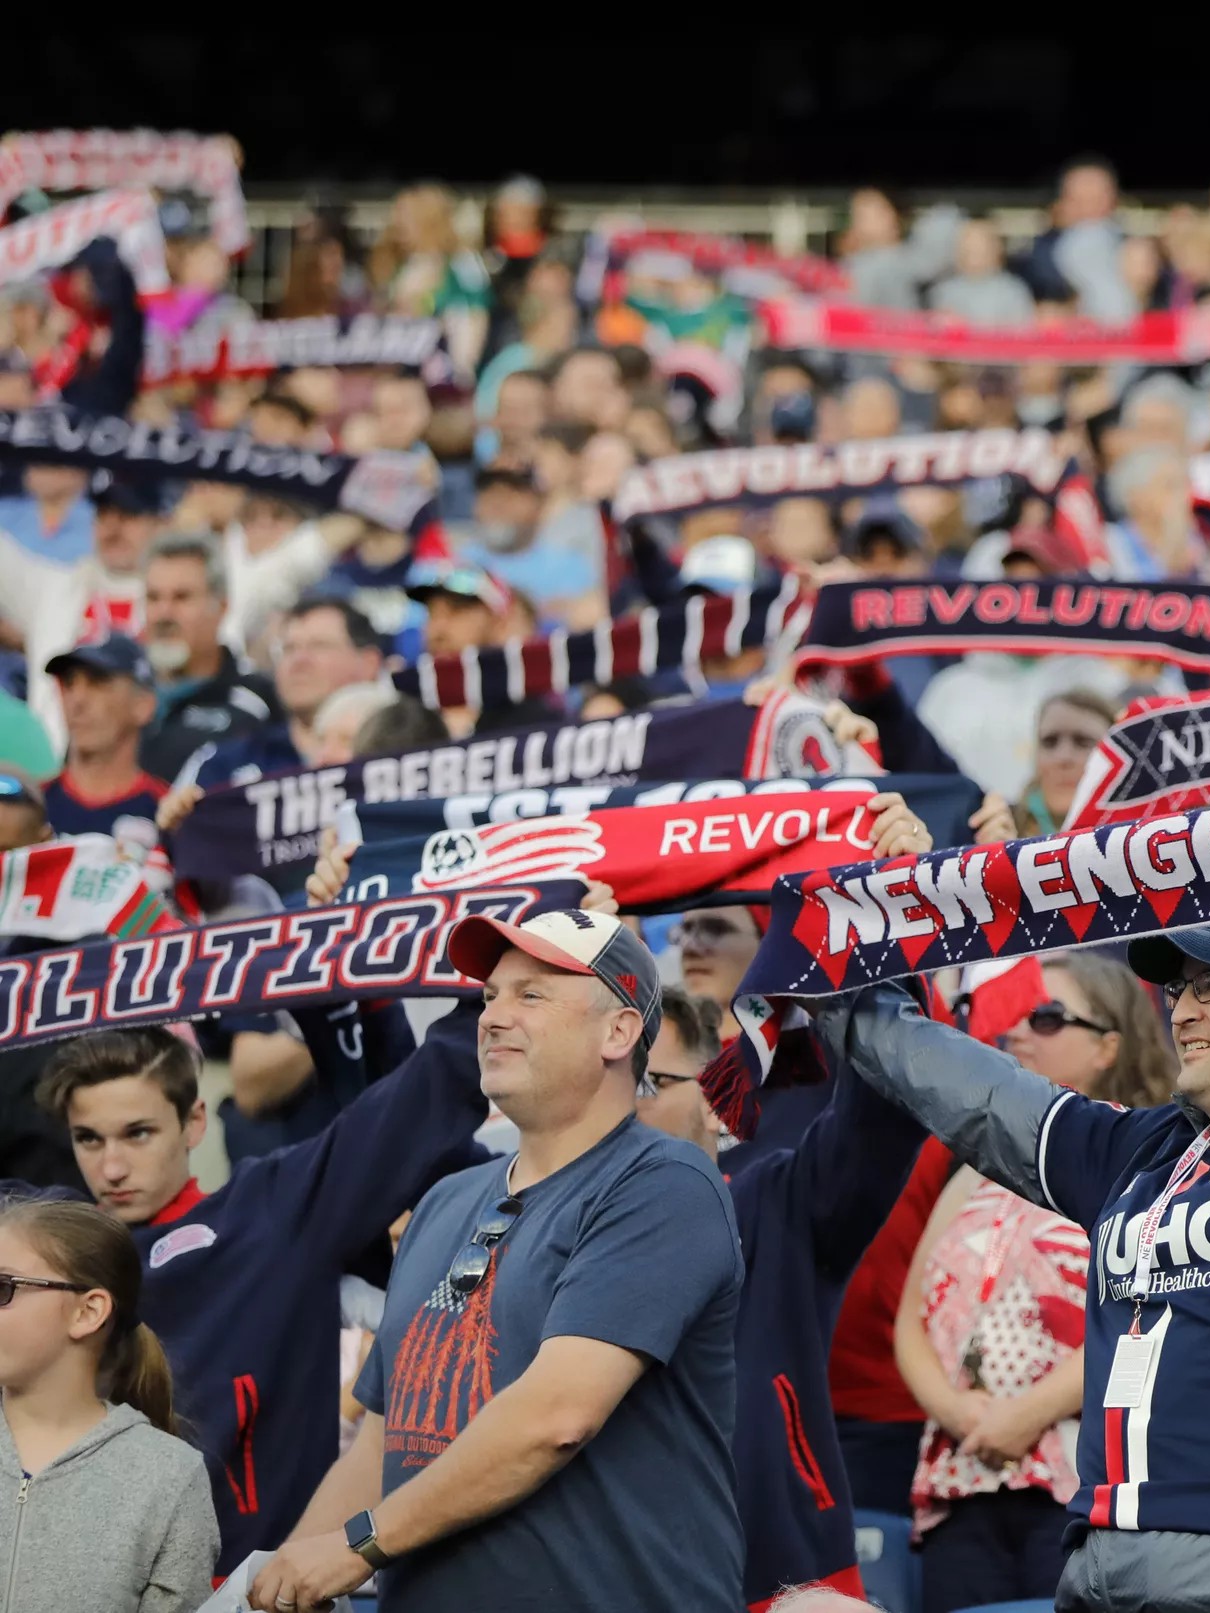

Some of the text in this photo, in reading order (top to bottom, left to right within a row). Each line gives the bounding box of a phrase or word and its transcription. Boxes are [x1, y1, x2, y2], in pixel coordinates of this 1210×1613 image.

[246, 712, 653, 840] THE REBELLION
[817, 850, 995, 955] NEW
